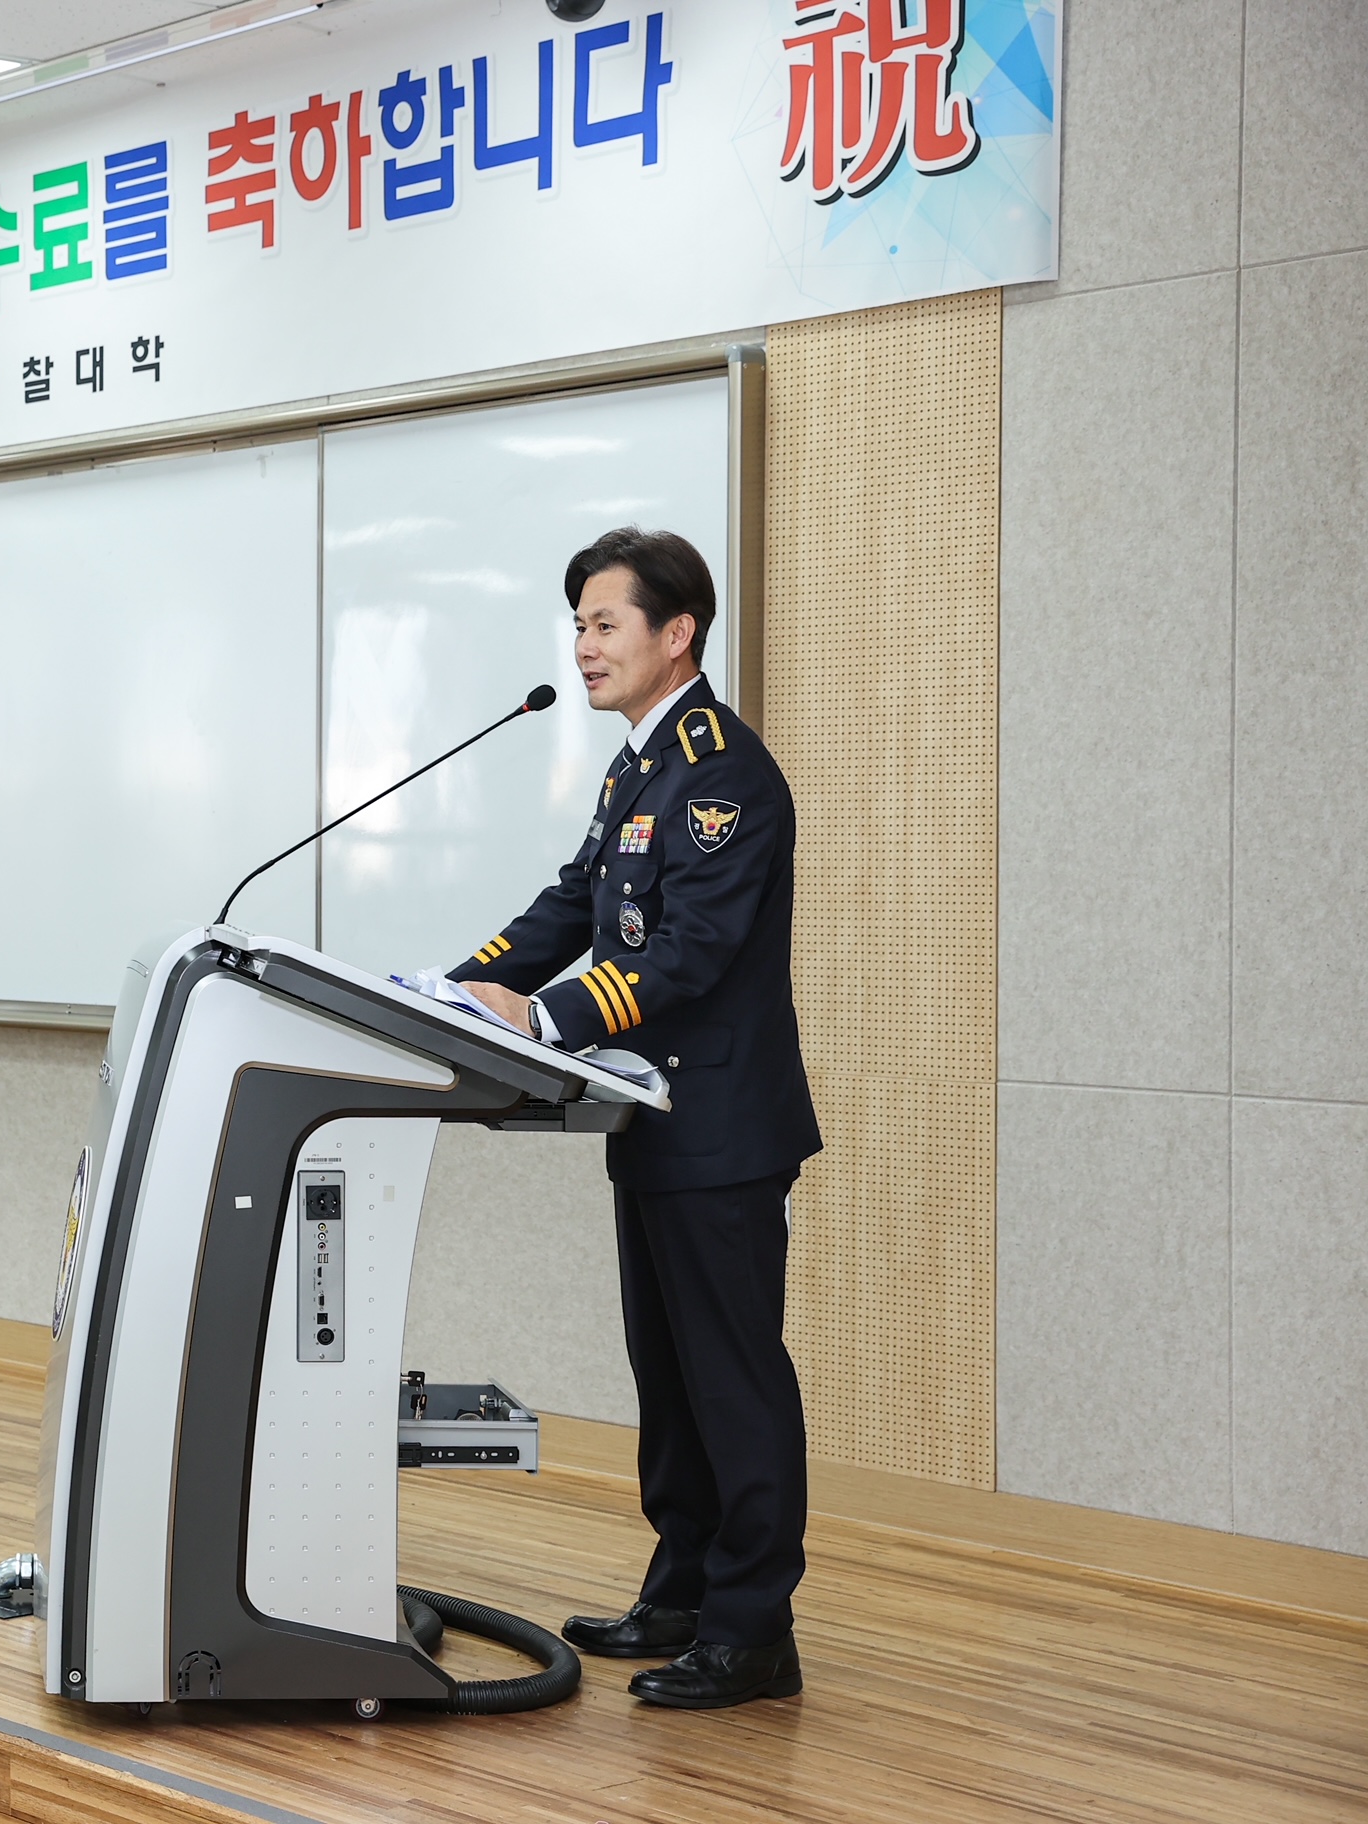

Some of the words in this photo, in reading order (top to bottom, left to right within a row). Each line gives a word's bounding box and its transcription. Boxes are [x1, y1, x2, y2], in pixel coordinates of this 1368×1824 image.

[205, 11, 673, 248] 축하합니다
[780, 0, 968, 191] 祝
[699, 834, 720, 842] POLICE
